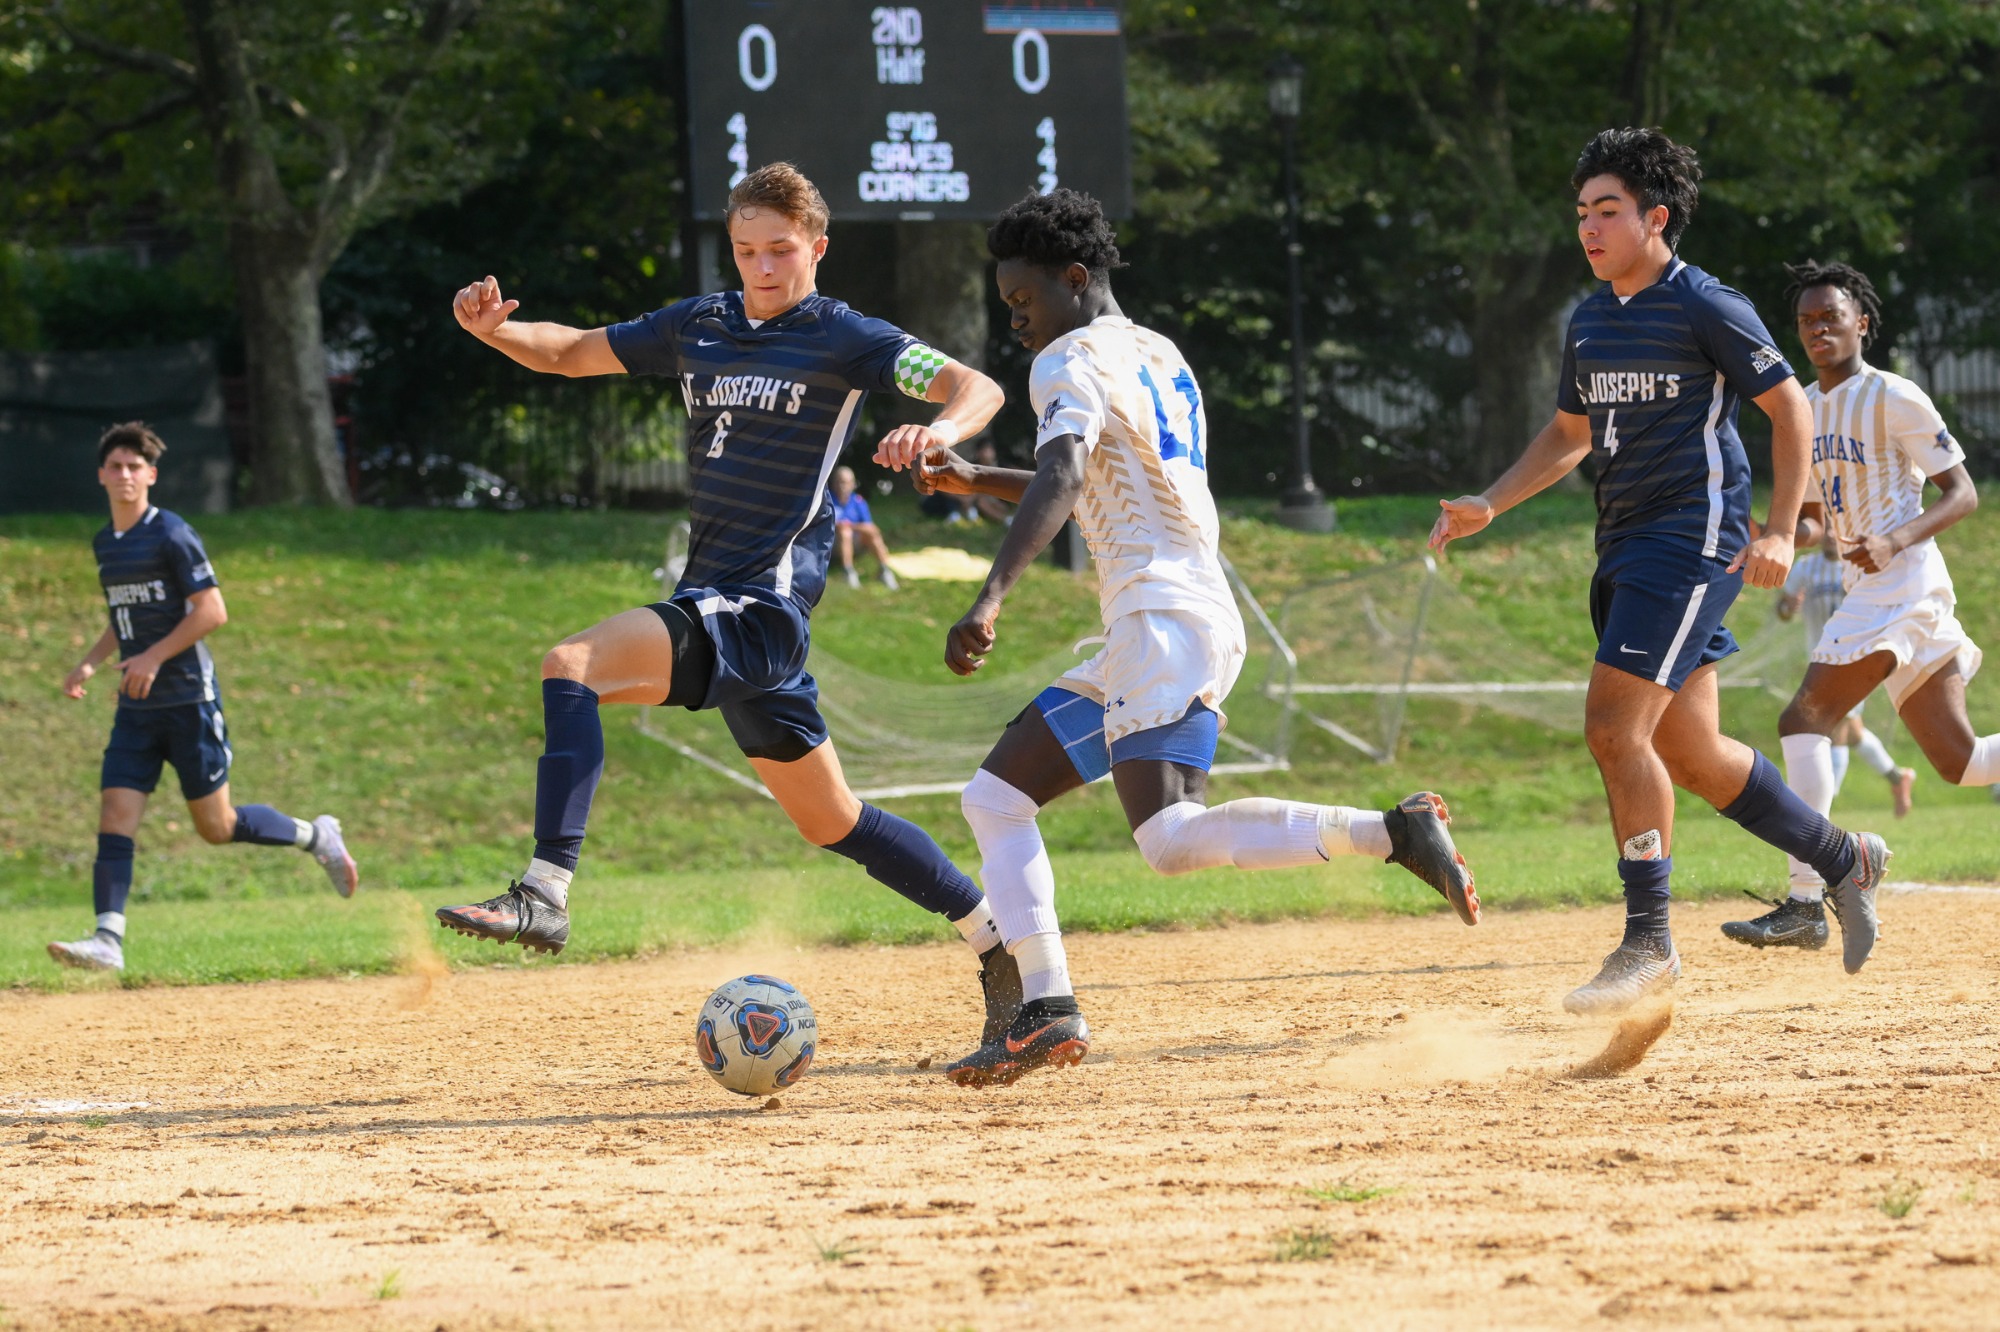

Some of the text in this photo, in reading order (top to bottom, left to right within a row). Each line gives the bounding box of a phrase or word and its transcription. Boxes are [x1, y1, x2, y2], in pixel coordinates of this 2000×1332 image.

[871, 6, 923, 46] 2ND
[738, 23, 777, 92] 0
[1012, 28, 1050, 94] 0
[726, 112, 748, 141] 4
[1036, 116, 1056, 145] 4
[727, 141, 749, 169] 4
[871, 141, 953, 171] SAVES
[1036, 145, 1057, 173] 4
[858, 171, 970, 201] CORNERS
[705, 375, 807, 415] JOSEPH'S
[1588, 371, 1681, 404] JOSEPH'S
[706, 410, 732, 459] 6
[1603, 408, 1619, 457] 4
[116, 606, 134, 640] 11
